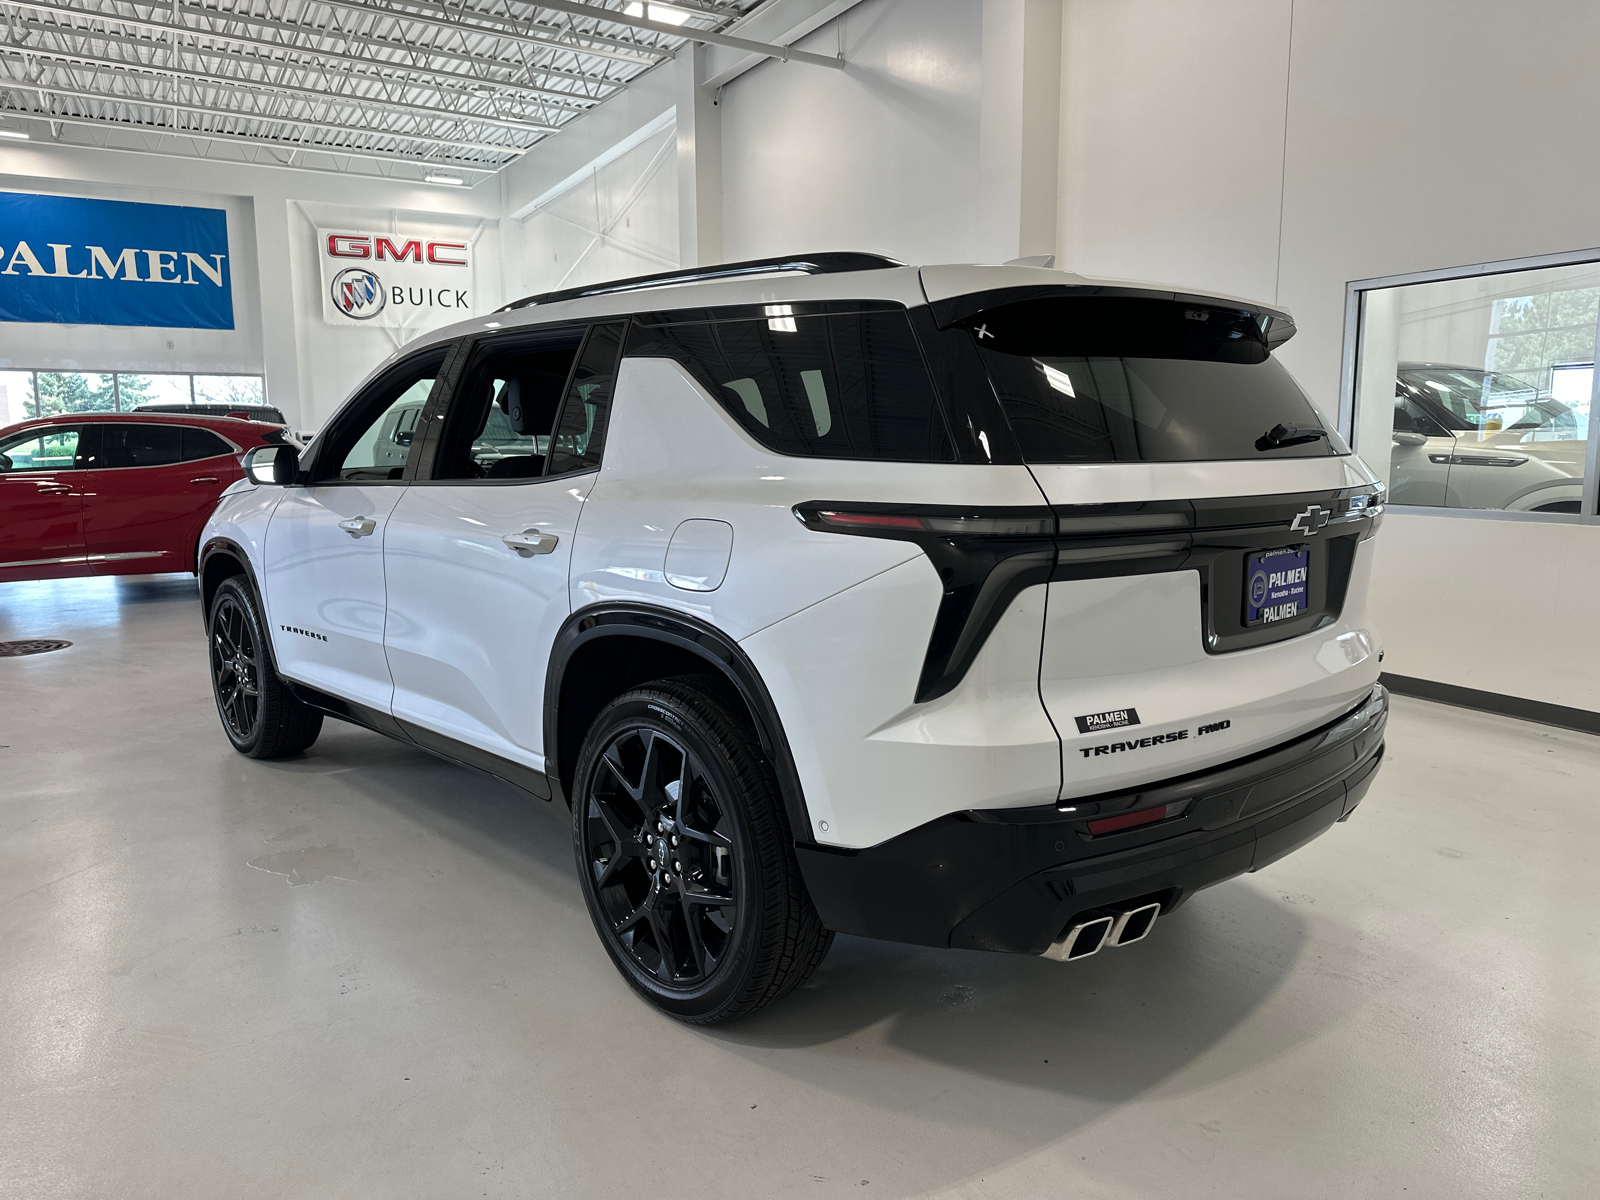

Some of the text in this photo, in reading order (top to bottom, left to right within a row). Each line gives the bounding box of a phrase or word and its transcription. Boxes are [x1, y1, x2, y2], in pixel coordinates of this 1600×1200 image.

[326, 232, 468, 267] GMC
[0, 240, 226, 287] ALMEN
[391, 286, 469, 309] BUICK
[1269, 567, 1307, 588] PALMEN
[1263, 601, 1297, 623] PALMEN
[280, 624, 328, 643] TRAVERSE
[1086, 710, 1129, 726] PALMEN
[1079, 719, 1231, 758] TRAVERSE AWD
